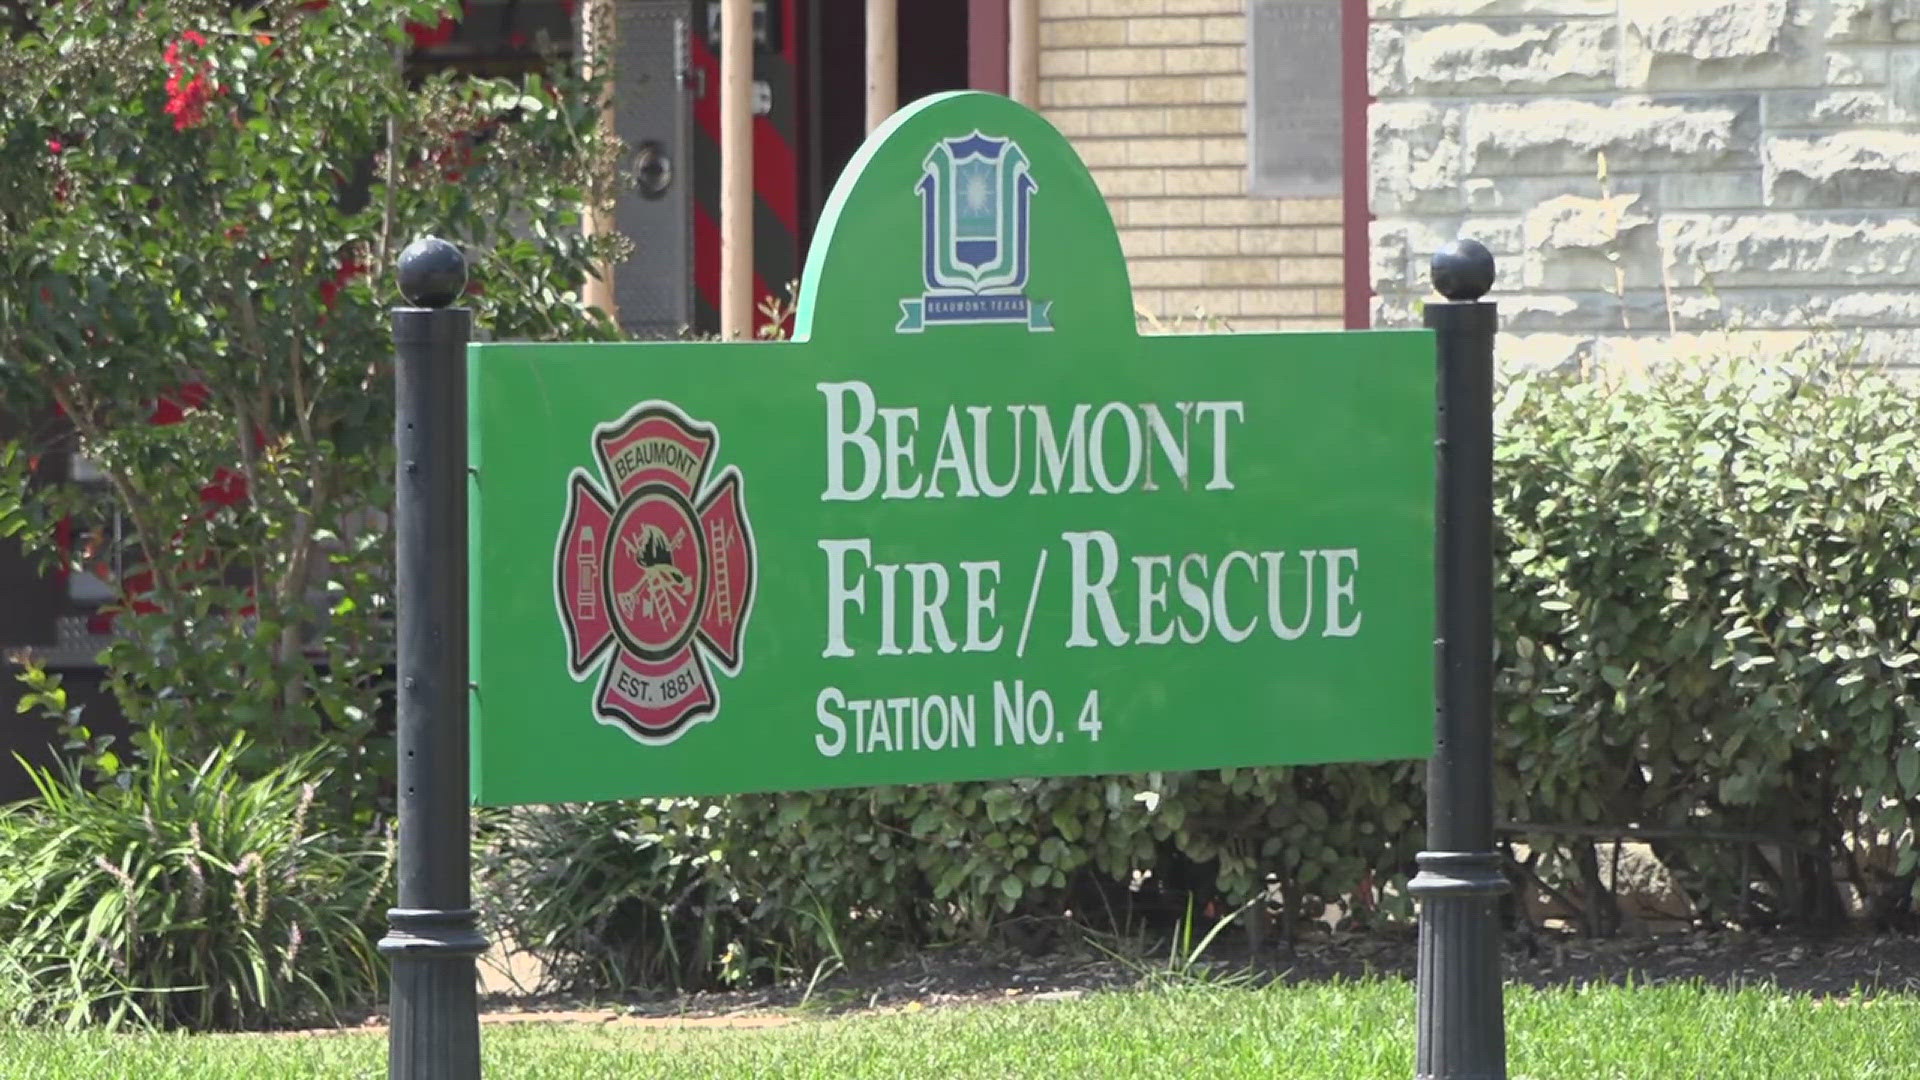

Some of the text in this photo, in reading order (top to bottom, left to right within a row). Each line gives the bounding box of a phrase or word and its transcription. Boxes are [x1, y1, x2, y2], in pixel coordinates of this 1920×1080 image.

[991, 300, 1025, 312] TEXAS
[816, 380, 1245, 501] BEAUMONT
[615, 442, 697, 480] BEAUMONT
[617, 669, 695, 701] EST. 1881
[815, 680, 1102, 757] STATION NO. 4
